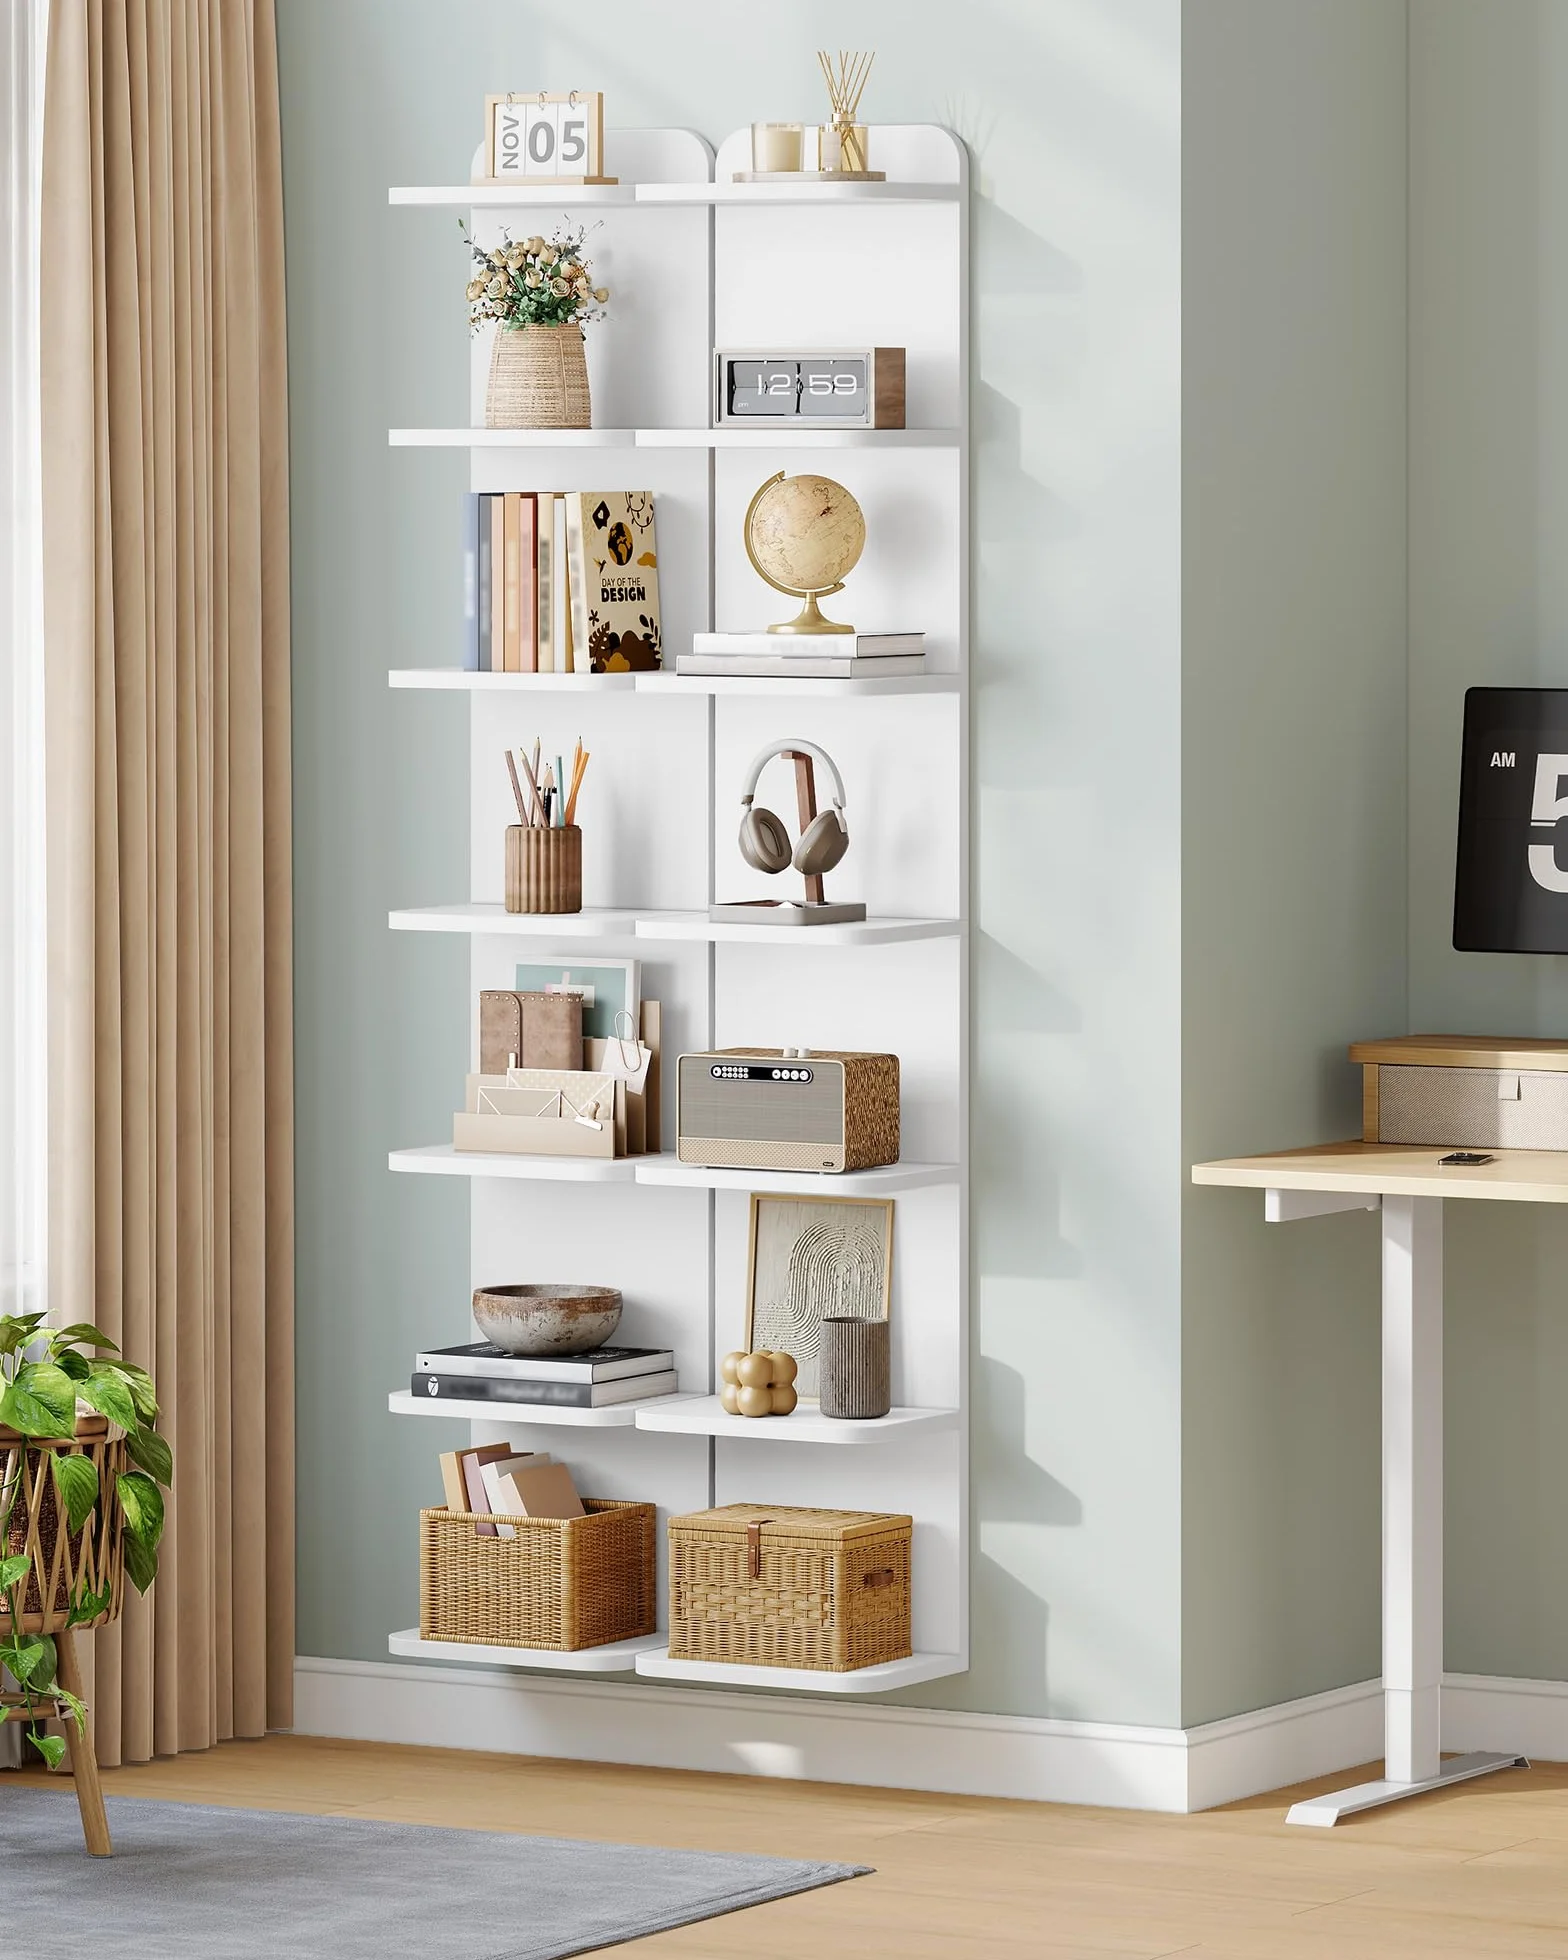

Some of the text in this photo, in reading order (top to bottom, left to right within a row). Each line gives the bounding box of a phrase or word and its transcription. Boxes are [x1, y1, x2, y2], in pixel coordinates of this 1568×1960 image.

[502, 115, 520, 169] NOV
[528, 121, 585, 163] 05
[602, 577, 641, 587] DAY OF THE
[601, 586, 646, 602] DESIGN
[1490, 752, 1516, 767] AM
